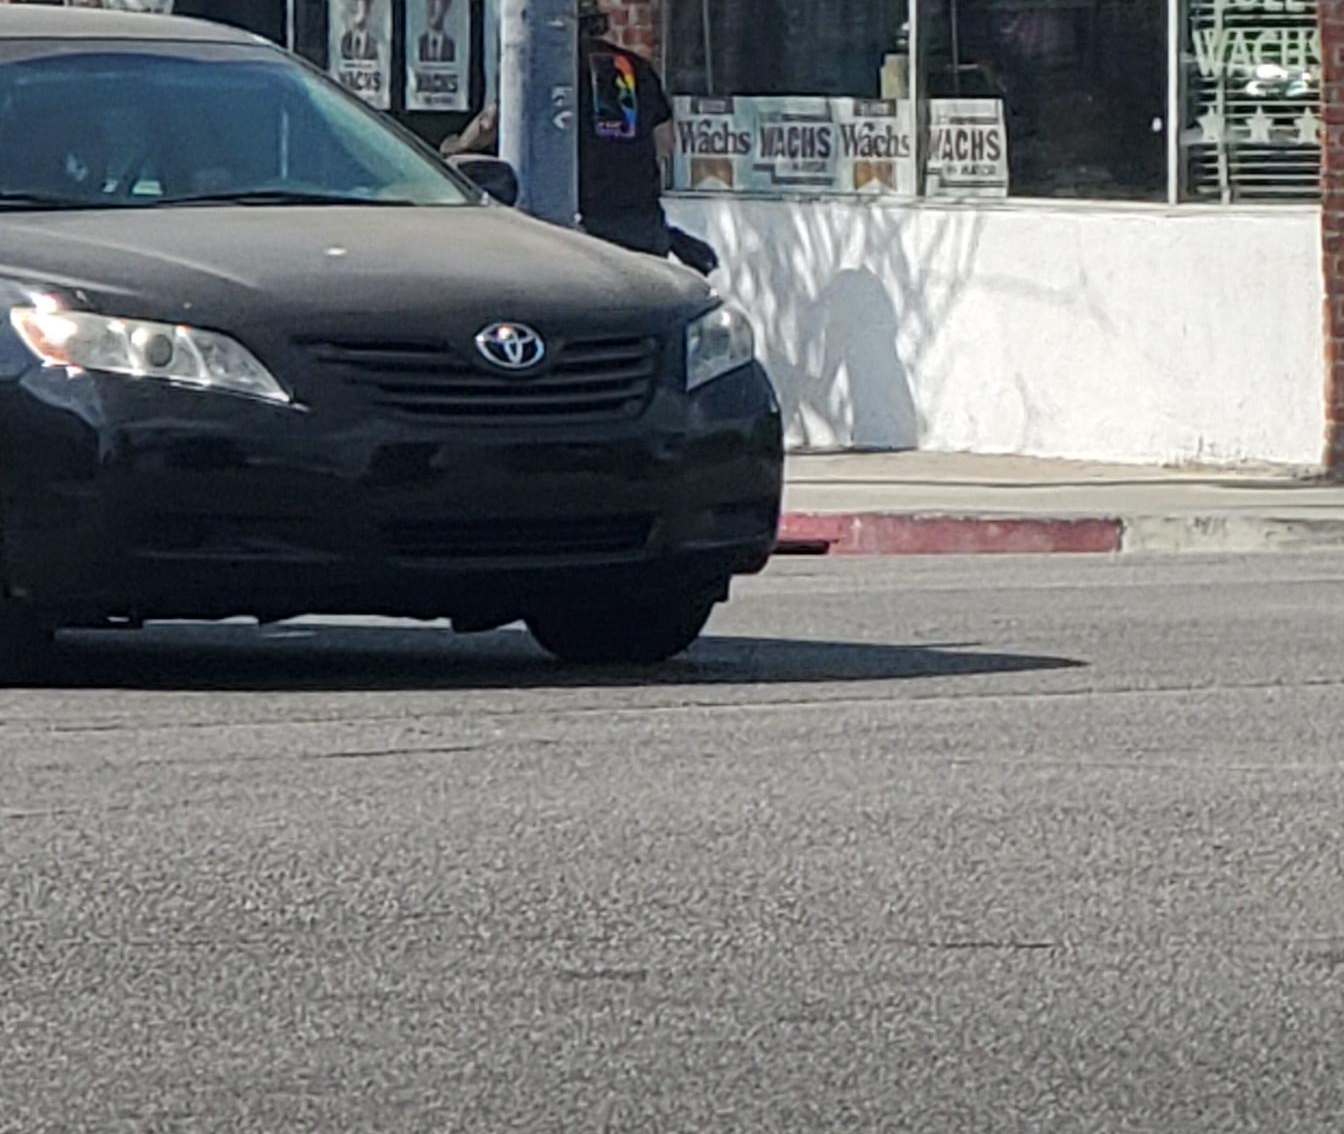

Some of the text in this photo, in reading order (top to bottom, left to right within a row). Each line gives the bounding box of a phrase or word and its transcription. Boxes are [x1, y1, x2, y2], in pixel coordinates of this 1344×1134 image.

[677, 118, 751, 155] Wachs
[760, 125, 832, 160] WACHS
[839, 120, 911, 158] Wachs
